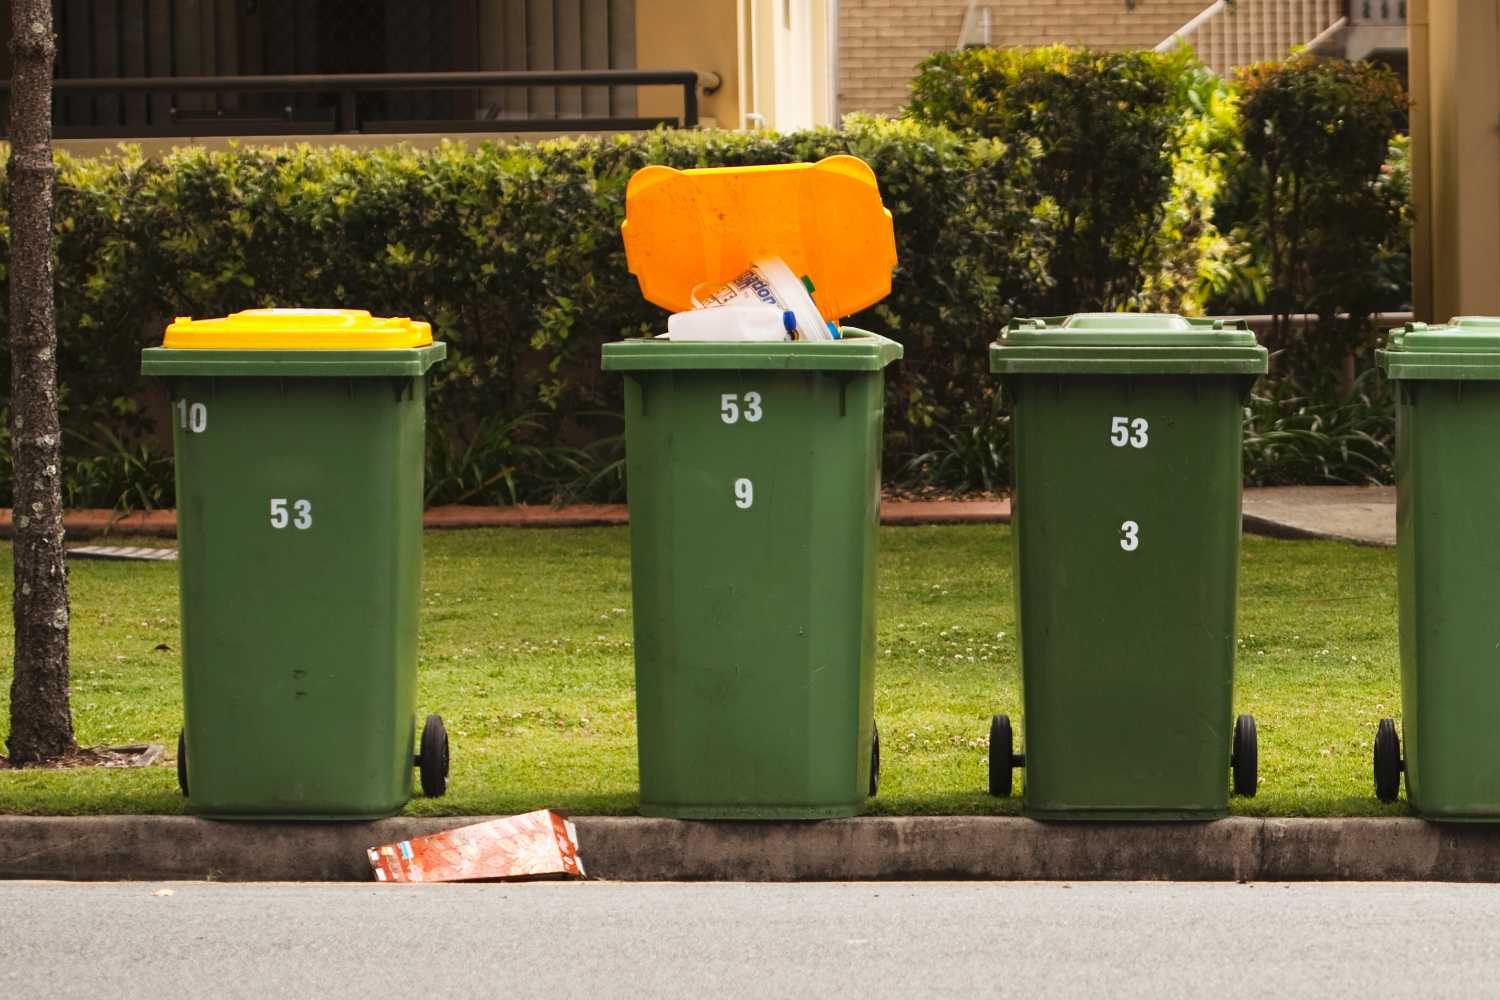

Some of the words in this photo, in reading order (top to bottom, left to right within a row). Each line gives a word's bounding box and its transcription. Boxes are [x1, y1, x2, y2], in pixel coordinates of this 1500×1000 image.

[176, 398, 208, 433] 10
[720, 391, 763, 425] 53
[1110, 416, 1149, 449] 53
[734, 477, 754, 509] 9
[270, 498, 313, 530] 53
[1120, 520, 1139, 552] 3
